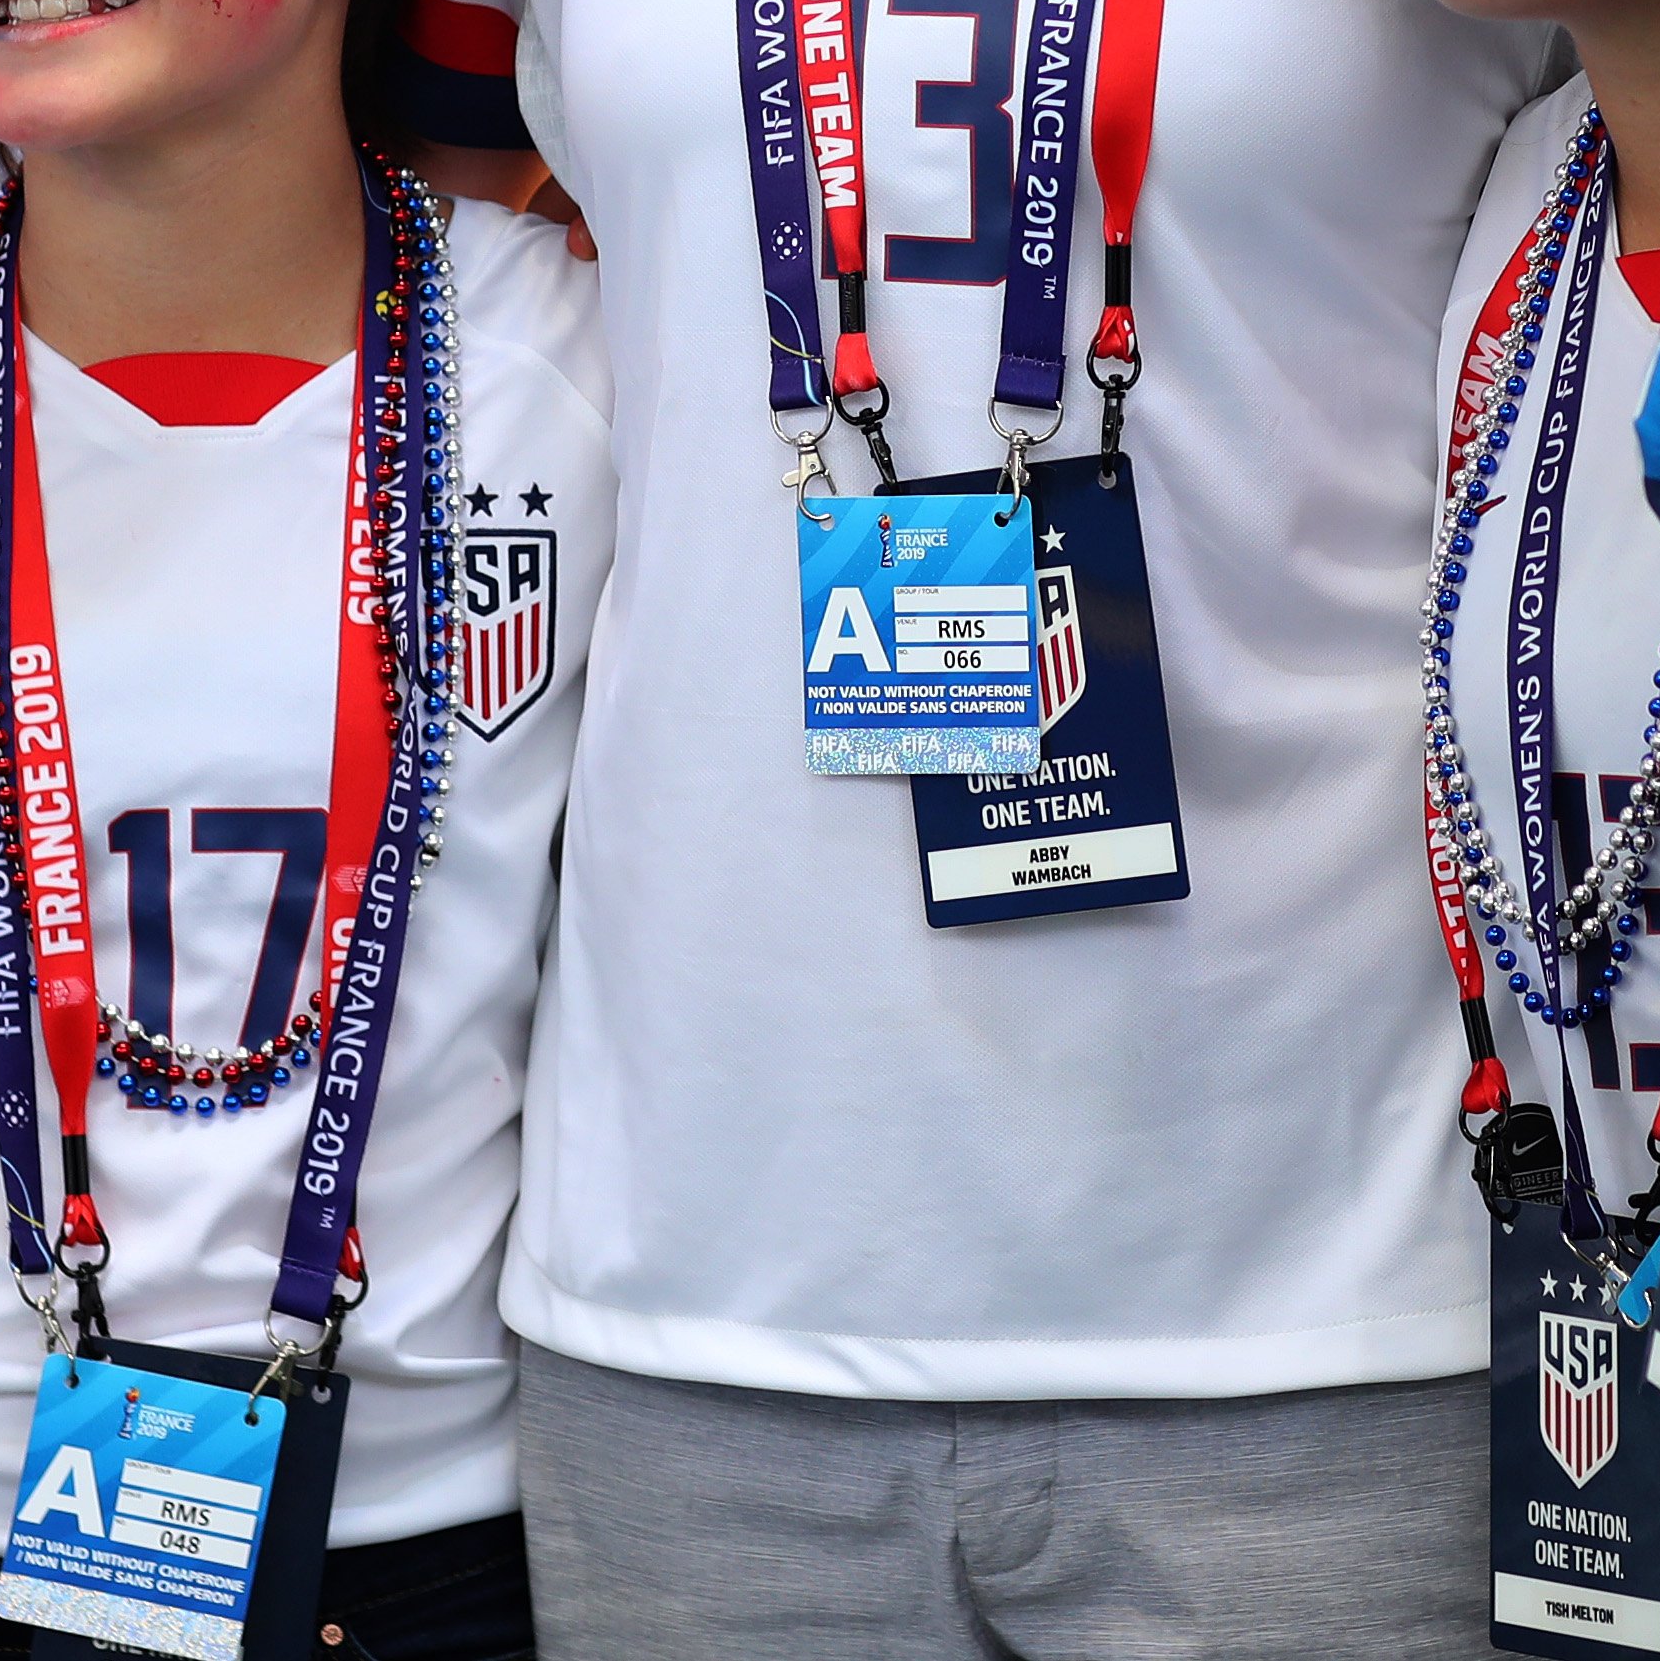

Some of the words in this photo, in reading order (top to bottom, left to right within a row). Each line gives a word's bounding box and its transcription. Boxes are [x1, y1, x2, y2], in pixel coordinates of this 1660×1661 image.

[758, 76, 796, 171] FIFA
[806, 70, 859, 211] TEAM
[1019, 173, 1059, 270] 2019
[1554, 236, 1598, 402] FRANCE
[1535, 413, 1565, 501] CUP
[895, 533, 949, 548] FRANCE
[896, 548, 926, 560] 2019
[1515, 504, 1555, 668] WORLD
[806, 586, 892, 673] A
[938, 619, 986, 639] RMS
[943, 649, 982, 669] 066
[8, 642, 69, 756] 2019
[807, 686, 840, 699] NOT
[841, 686, 881, 698] VALID
[883, 685, 947, 698] WITHOUT
[949, 684, 1032, 698] CHAPERONE
[823, 701, 854, 715] NON
[857, 701, 907, 714] VALIDE
[909, 701, 947, 714] SANS
[950, 700, 1025, 713] CHAPERON
[902, 734, 941, 752] FIFA
[992, 733, 1031, 752] FIFA
[1021, 752, 1117, 787] NATION.
[981, 804, 1032, 830] ONE
[1034, 790, 1112, 824] TEAM.
[1515, 675, 1545, 893] WOMEN'S
[22, 758, 87, 958] FRANCE
[1012, 863, 1092, 887] WAMBACH
[1029, 845, 1070, 864] ABBY
[366, 842, 402, 931] CUP
[107, 807, 328, 1110] 17
[1534, 901, 1560, 992] FIFA
[323, 935, 388, 1102] FRANCE
[302, 1103, 352, 1199] 2019
[1544, 1320, 1614, 1390] USA
[137, 1409, 196, 1435] FRANCE
[16, 1443, 106, 1538] A
[160, 1499, 213, 1528] RMS
[159, 1530, 202, 1556] 048
[1527, 1499, 1562, 1531] ONE
[1565, 1507, 1632, 1544] NATION.
[12, 1532, 45, 1551] NOT
[45, 1539, 91, 1560] VALID
[91, 1549, 157, 1572] WITHOUT
[158, 1563, 246, 1594] CHAPERONE
[23, 1551, 60, 1570] NON
[60, 1559, 115, 1582] VALIDE
[114, 1570, 156, 1591] SANS
[156, 1578, 236, 1607] CHAPERON
[1534, 1539, 1570, 1570] ONE
[1572, 1545, 1625, 1580] TEAM.
[1545, 1600, 1570, 1620] TISH
[1571, 1604, 1615, 1626] MELTON
